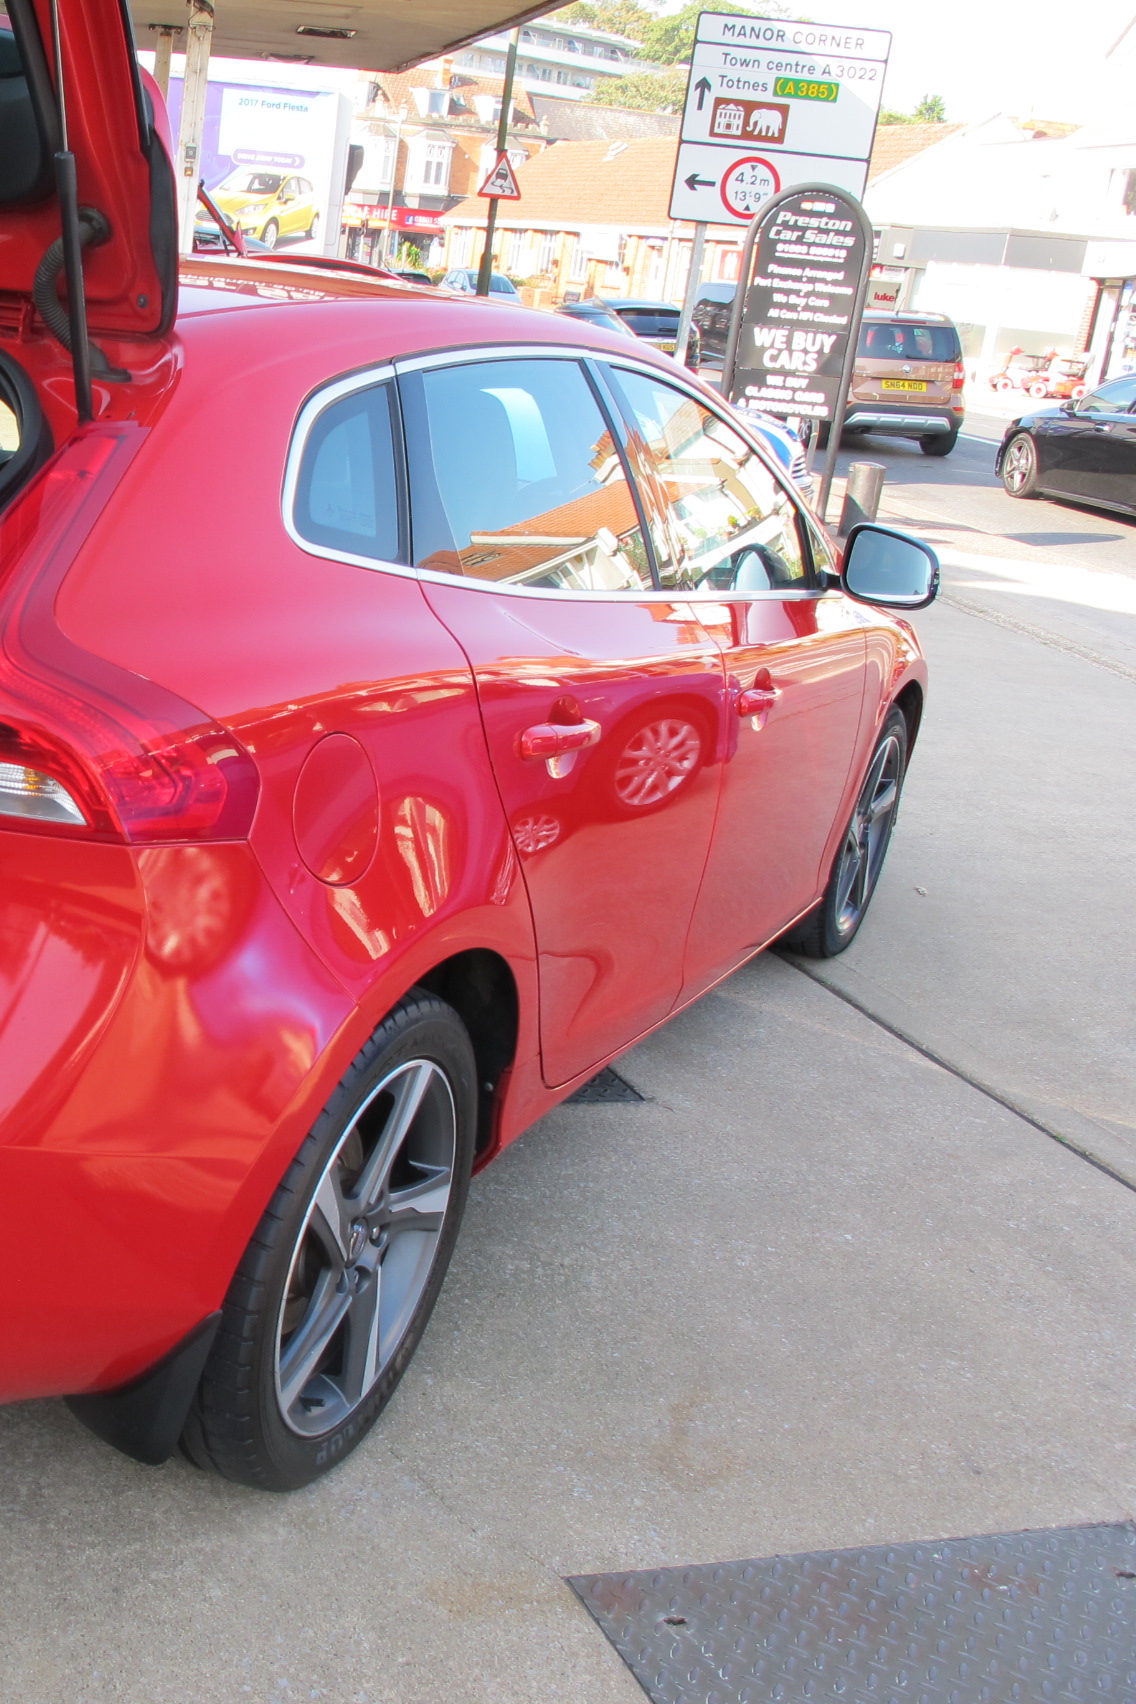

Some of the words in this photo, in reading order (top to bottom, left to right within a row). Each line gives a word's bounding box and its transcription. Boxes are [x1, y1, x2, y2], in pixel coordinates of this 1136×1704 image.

[722, 23, 786, 43] MANOR
[792, 31, 865, 51] CORNER
[722, 52, 760, 70] Town
[766, 58, 816, 75] centre
[718, 74, 769, 93] Totnes
[775, 78, 839, 102] (A385)
[238, 98, 259, 107] 2017
[261, 100, 281, 109] Ford
[283, 102, 309, 112] Fiesta
[372, 207, 398, 220] HIRE
[776, 211, 852, 231] Preston
[769, 226, 802, 241] Car
[803, 229, 856, 247] Sales
[767, 263, 803, 276] Finance
[803, 267, 845, 281] Arranged
[754, 276, 772, 287] Part
[772, 278, 814, 292] Exchange
[814, 282, 853, 295] Welcome
[773, 293, 788, 303] We
[788, 294, 808, 307] Buy
[808, 296, 830, 307] Cars
[767, 308, 780, 318] All
[780, 309, 798, 320] Cars
[753, 327, 789, 349] WE
[791, 331, 837, 354] BUY
[763, 348, 818, 372] CARS
[766, 374, 785, 387] WE
[785, 376, 809, 389] BUY
[884, 380, 906, 389] SN64
[745, 385, 794, 400] CLASSIC
[794, 390, 825, 404] CARS
[748, 399, 829, 417] MOTORCYCLES
